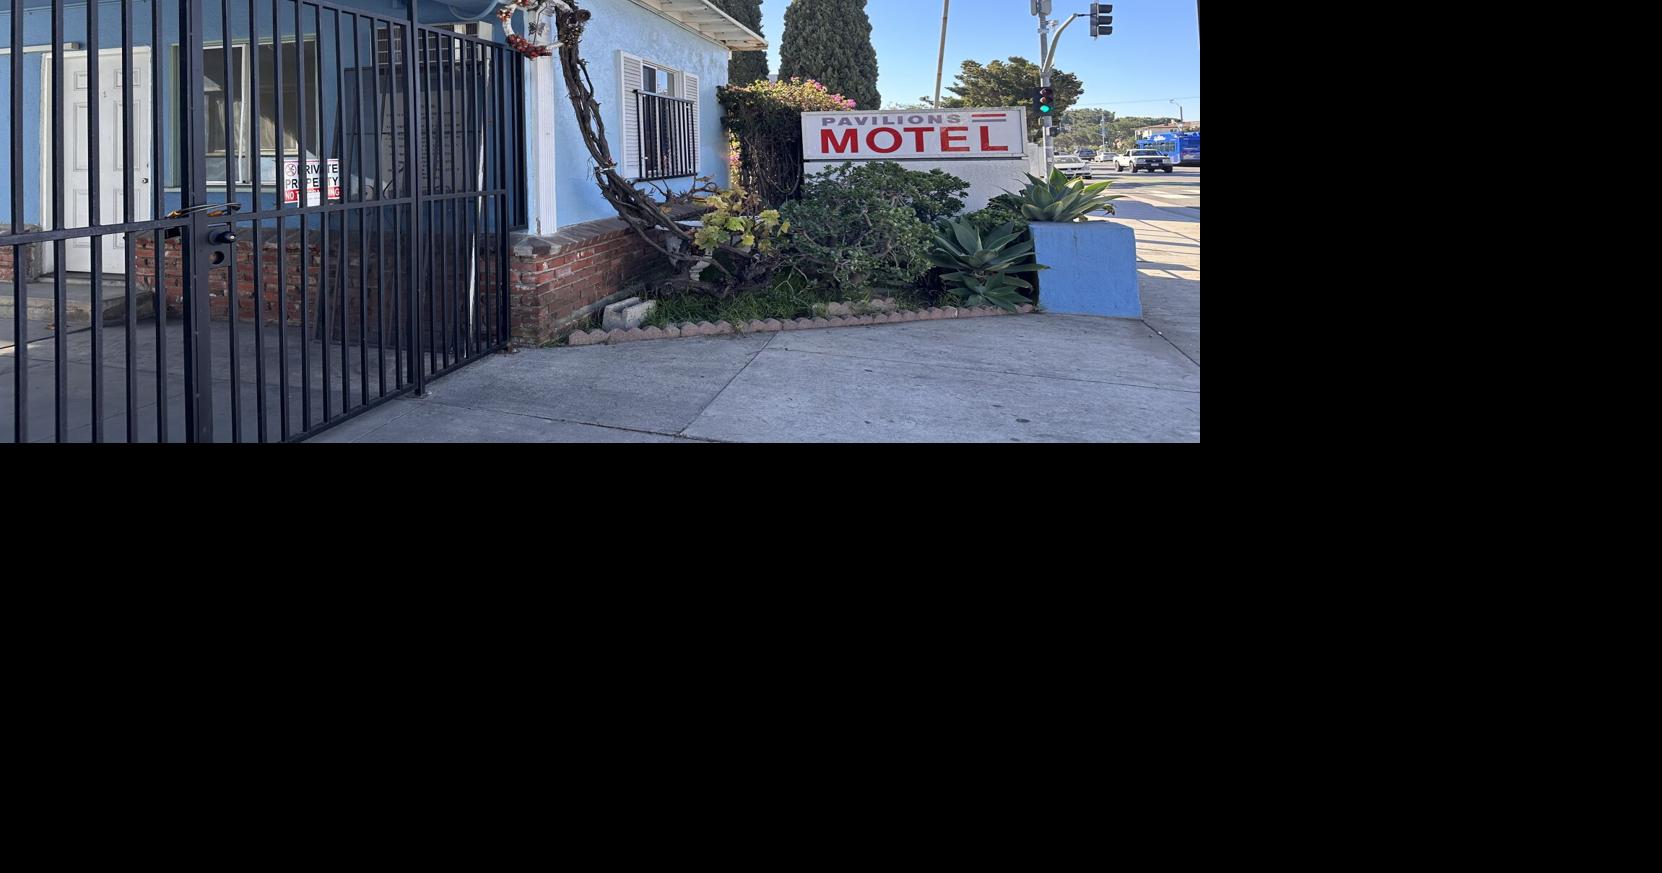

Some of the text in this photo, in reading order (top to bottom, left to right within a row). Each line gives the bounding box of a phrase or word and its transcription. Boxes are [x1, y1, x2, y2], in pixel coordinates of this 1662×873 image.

[821, 114, 961, 127] PAVILIONS
[820, 125, 1009, 154] MOTEL
[298, 163, 338, 175] RIVTE
[286, 176, 339, 189] PRPETY
